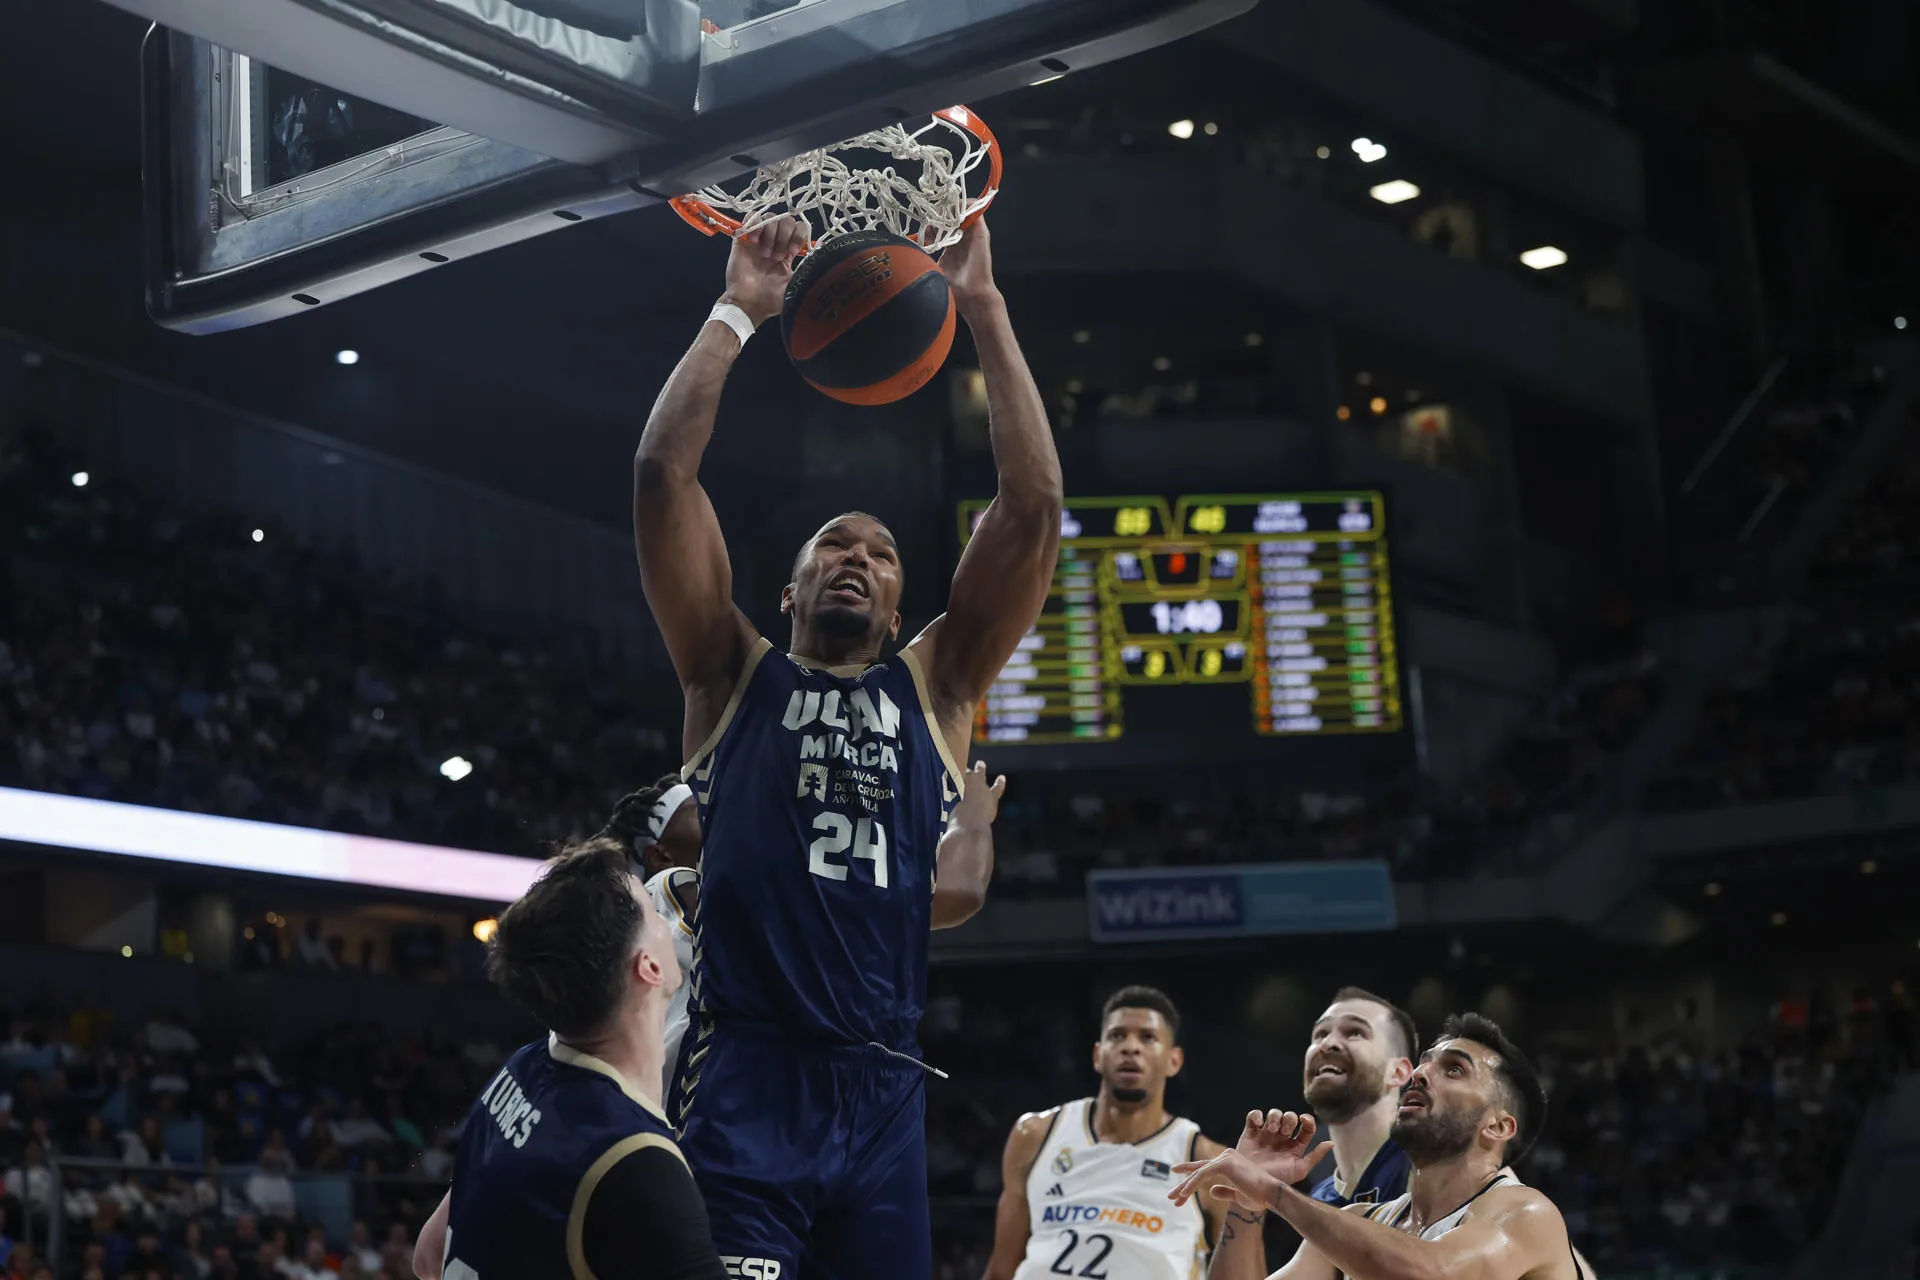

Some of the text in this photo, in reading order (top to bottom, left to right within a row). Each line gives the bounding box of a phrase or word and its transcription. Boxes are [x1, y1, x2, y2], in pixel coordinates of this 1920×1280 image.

[799, 733, 899, 774] MURCA
[857, 783, 879, 798] CRU
[809, 811, 889, 889] 24
[1042, 1204, 1164, 1234] AUTOHERO
[1050, 1228, 1114, 1280] 22
